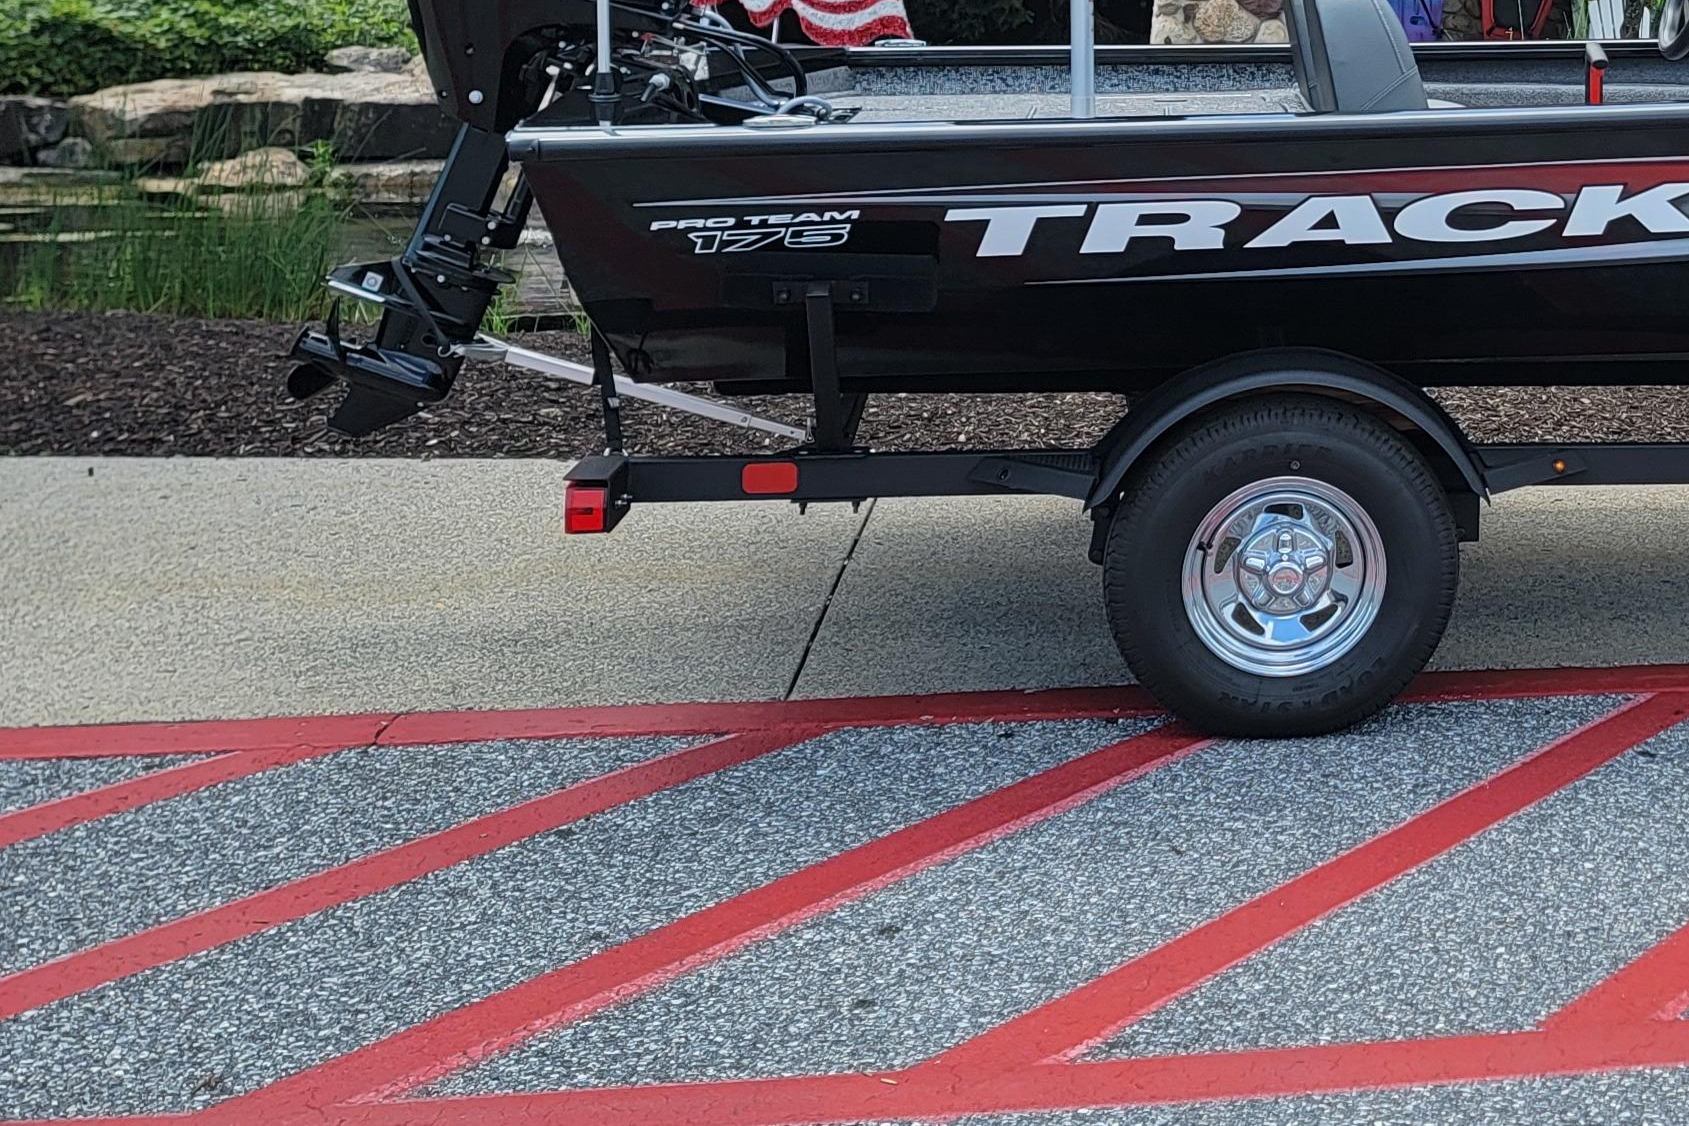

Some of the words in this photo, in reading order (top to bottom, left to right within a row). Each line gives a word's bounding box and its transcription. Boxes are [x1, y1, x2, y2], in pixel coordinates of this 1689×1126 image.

[650, 217, 736, 231] PRO
[743, 210, 861, 226] TEAM
[687, 224, 851, 254] 175
